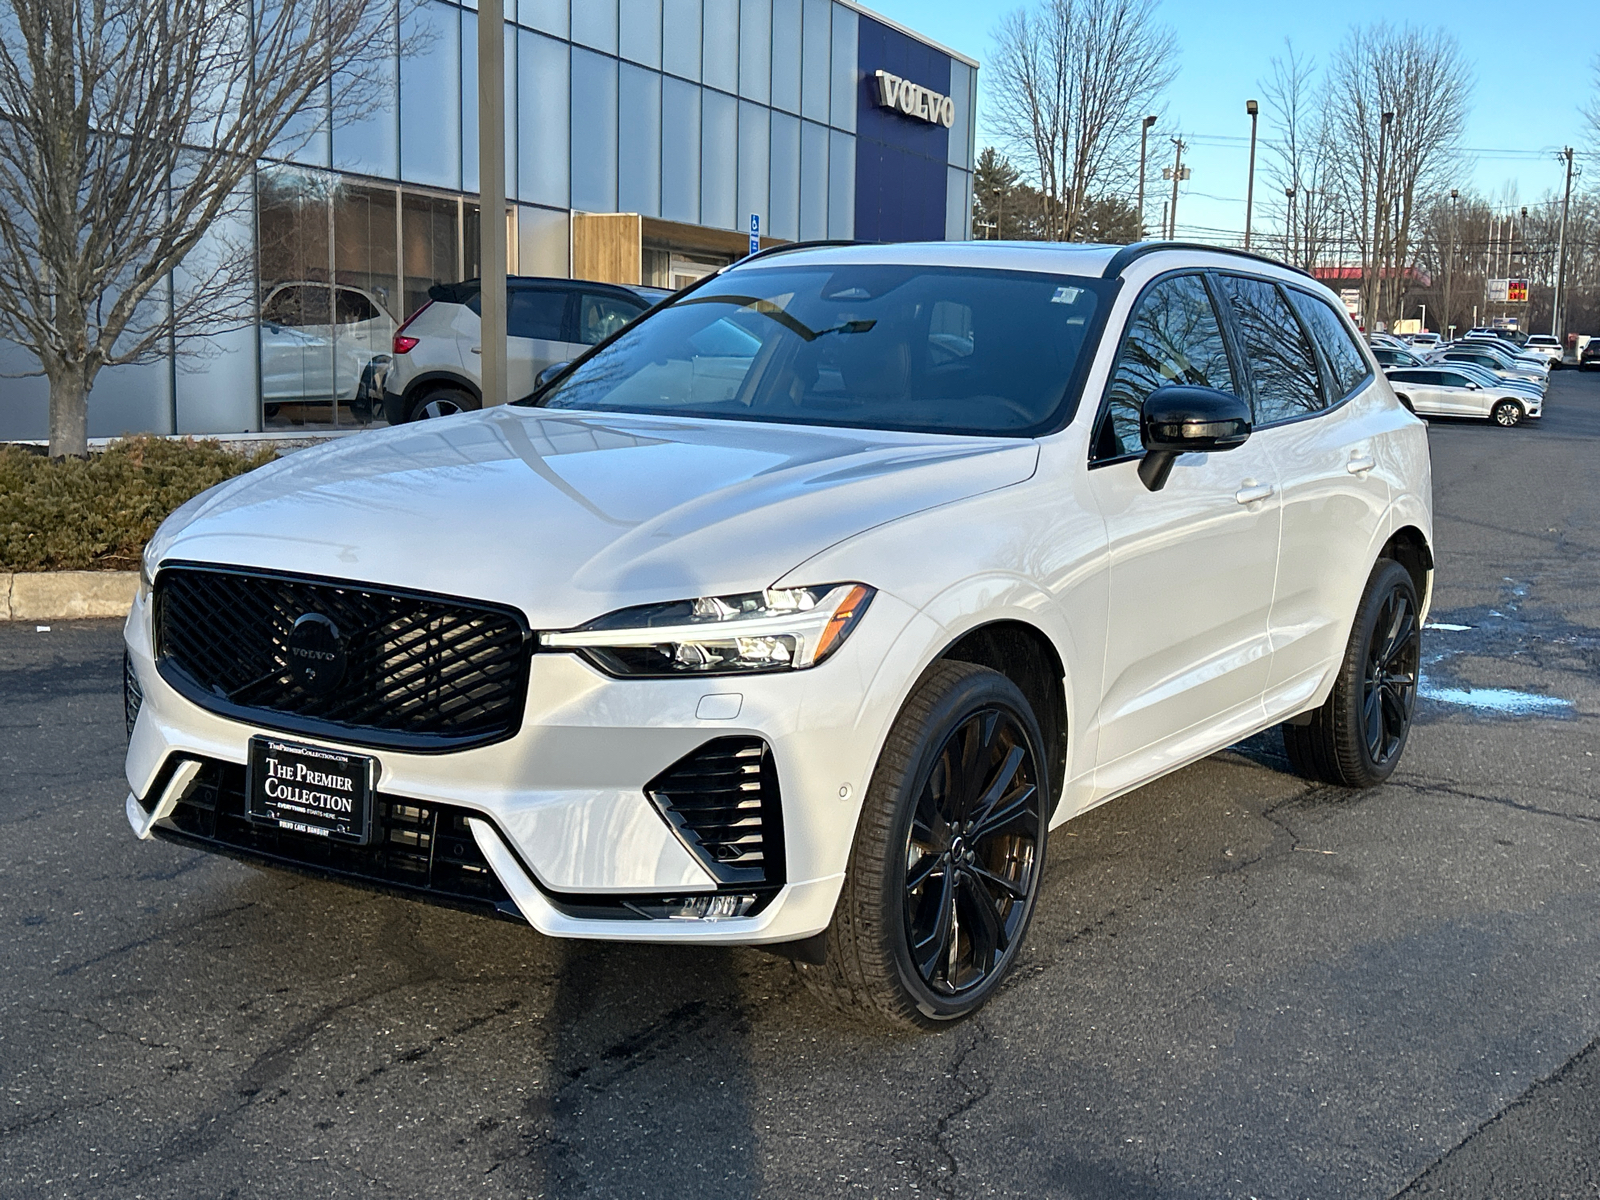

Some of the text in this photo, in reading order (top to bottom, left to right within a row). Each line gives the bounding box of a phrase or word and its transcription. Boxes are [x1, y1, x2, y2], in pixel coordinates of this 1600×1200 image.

[877, 70, 955, 129] VOLVO
[292, 647, 335, 661] VOLVO
[296, 763, 353, 792] PREMIER
[265, 778, 353, 812] COLLECTION
